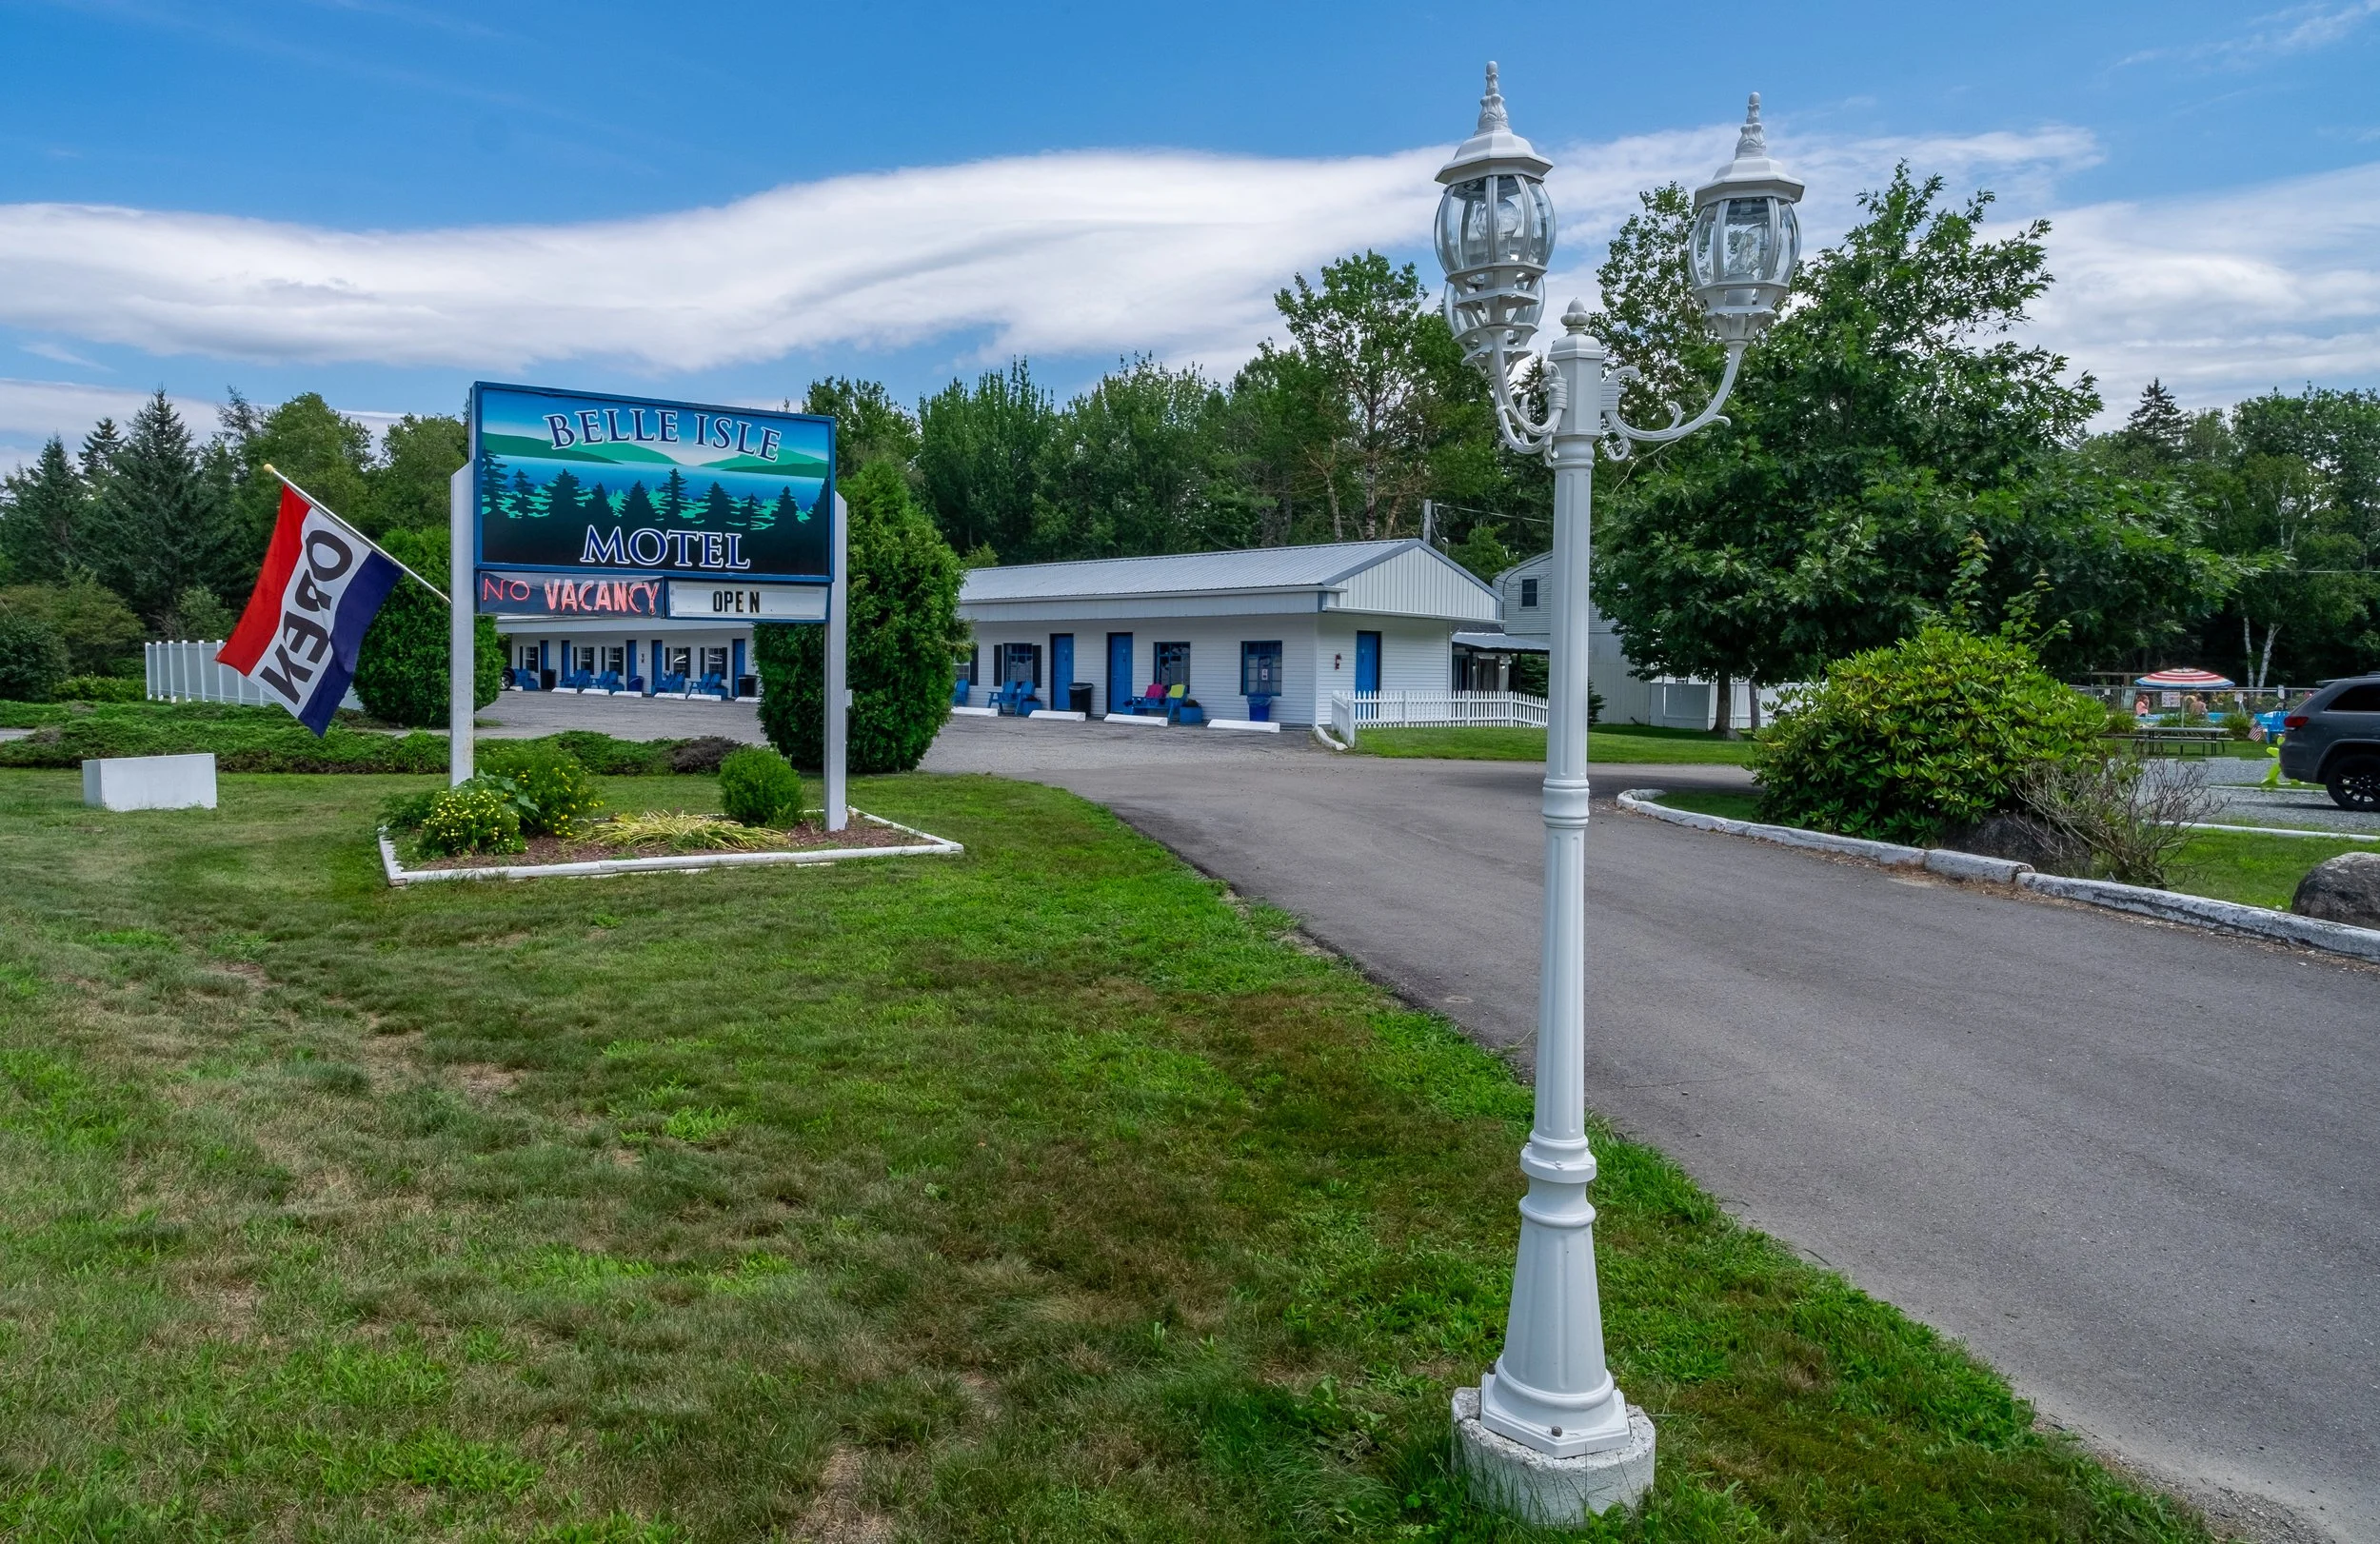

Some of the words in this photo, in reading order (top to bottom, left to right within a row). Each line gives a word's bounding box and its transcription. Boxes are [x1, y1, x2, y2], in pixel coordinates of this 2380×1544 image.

[544, 409, 679, 449] BELLE
[695, 414, 782, 463] ISLE
[580, 525, 750, 569] MOTEL
[483, 578, 530, 601] NO
[544, 579, 660, 615] VACANCY
[713, 590, 761, 613] OPEN
